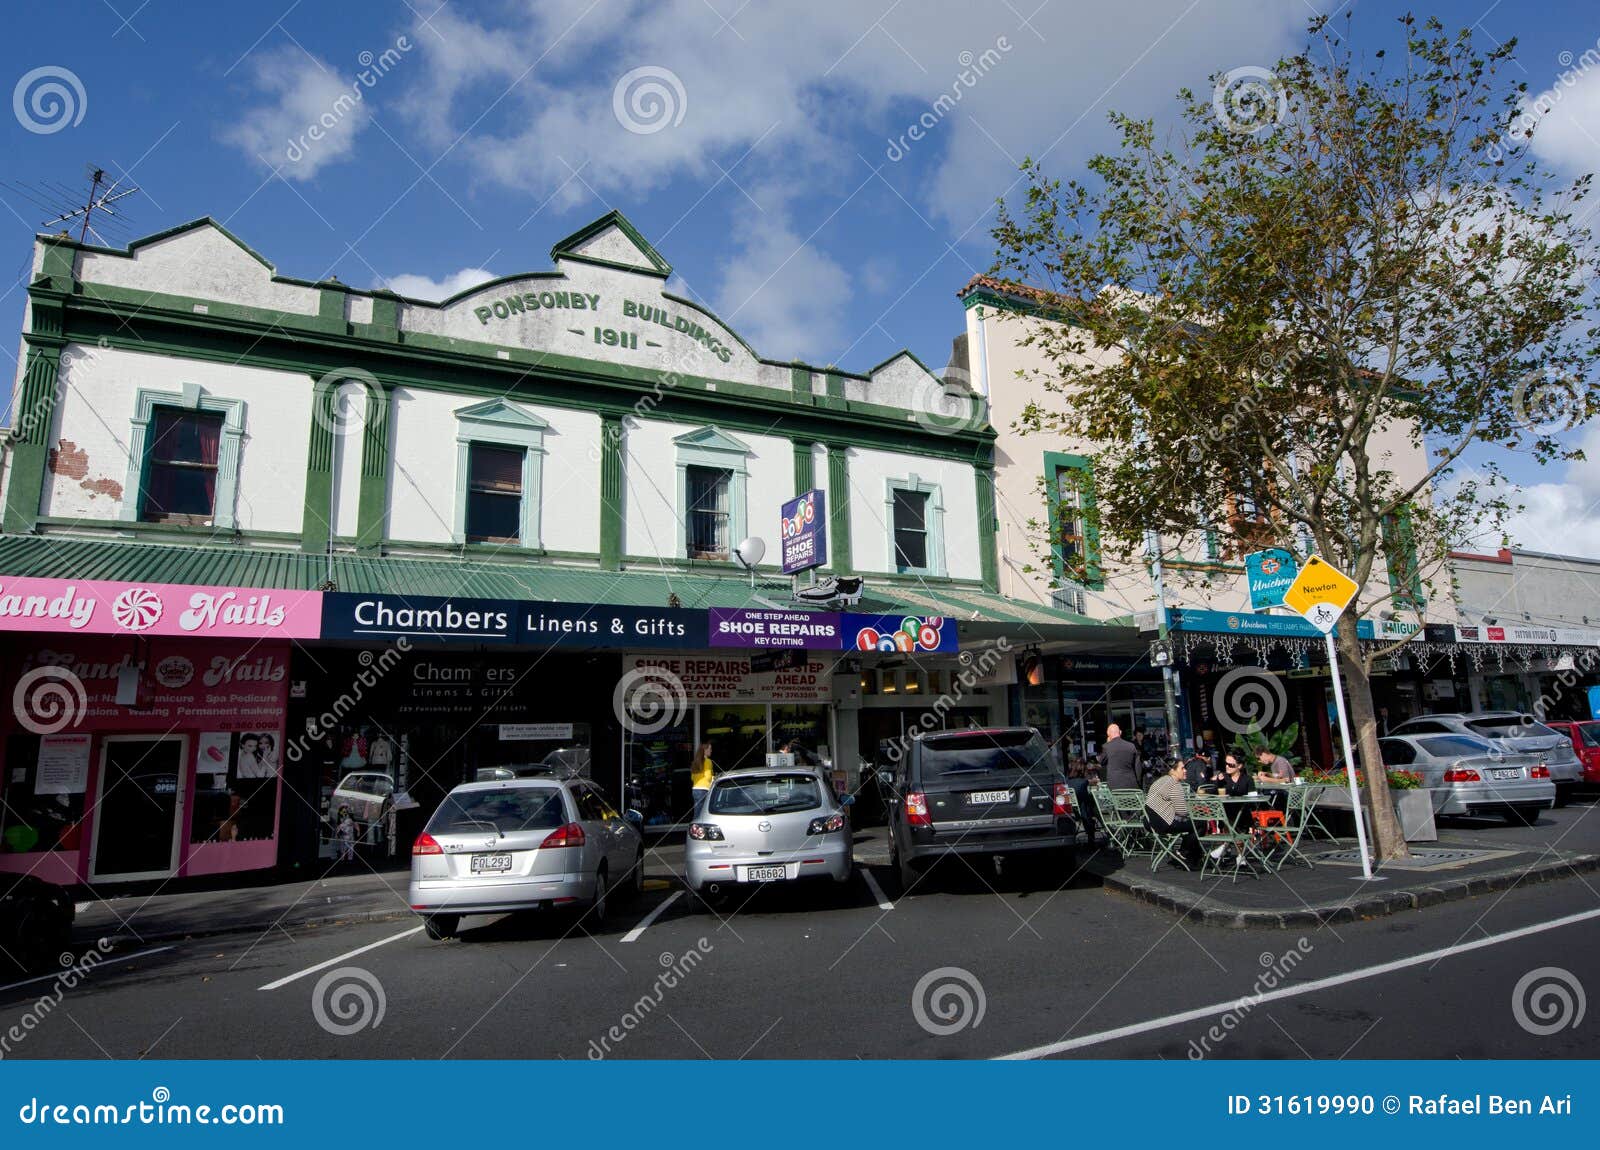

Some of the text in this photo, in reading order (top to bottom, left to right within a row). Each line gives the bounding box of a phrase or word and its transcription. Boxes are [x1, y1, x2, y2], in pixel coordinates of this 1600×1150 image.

[473, 291, 733, 363] PONSONBY BUILDINGS
[593, 326, 638, 350] 1911
[786, 539, 813, 556] SHOE
[786, 549, 813, 564] REPAIRS
[1303, 583, 1337, 594] Newton
[0, 586, 286, 631] andy Nails
[354, 601, 508, 630] Chambers
[527, 615, 685, 636] Linens & Gifts
[719, 621, 835, 637] SHOE REPAIRS
[754, 637, 804, 646] KEY CUTTING
[860, 618, 939, 652] LOTTO
[203, 654, 286, 686] Nails
[413, 662, 517, 682] Chamers
[635, 659, 680, 674] SHOE
[685, 660, 750, 675] REPAIRS
[680, 675, 742, 683] CUTTING
[775, 675, 816, 685] AHEAD
[206, 694, 226, 706] Spa
[230, 694, 278, 705] Pedicure
[413, 688, 458, 698] Linens
[480, 688, 515, 698] Gifts
[697, 691, 731, 699] CARE
[177, 707, 237, 717] Permanent
[240, 707, 283, 719] makeup
[155, 784, 176, 793] OPEN
[974, 792, 1007, 802] EAY683
[749, 868, 784, 880] EAB602
